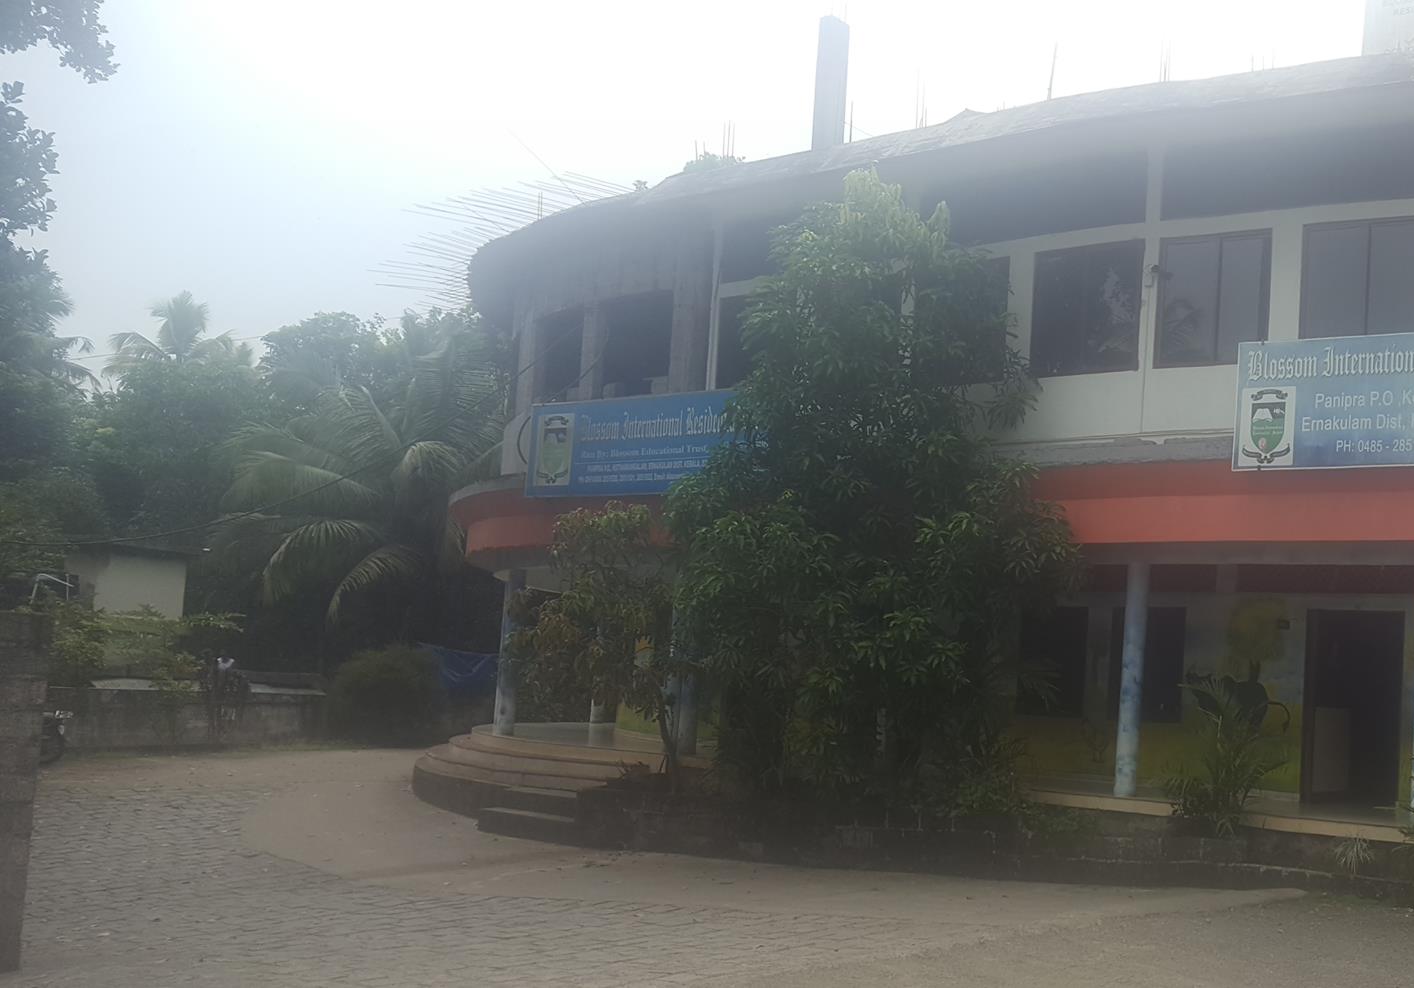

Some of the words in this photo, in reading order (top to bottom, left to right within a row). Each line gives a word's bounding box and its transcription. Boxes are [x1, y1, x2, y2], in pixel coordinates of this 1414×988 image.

[1247, 349, 1317, 381] Blossom
[1314, 392, 1366, 411] Panipra
[1369, 390, 1393, 406] P.O
[621, 408, 682, 440] International
[1301, 414, 1372, 432] Ernakulam
[1376, 413, 1405, 431] Dist,
[1335, 440, 1354, 453] PH:
[1357, 440, 1383, 453] 0485
